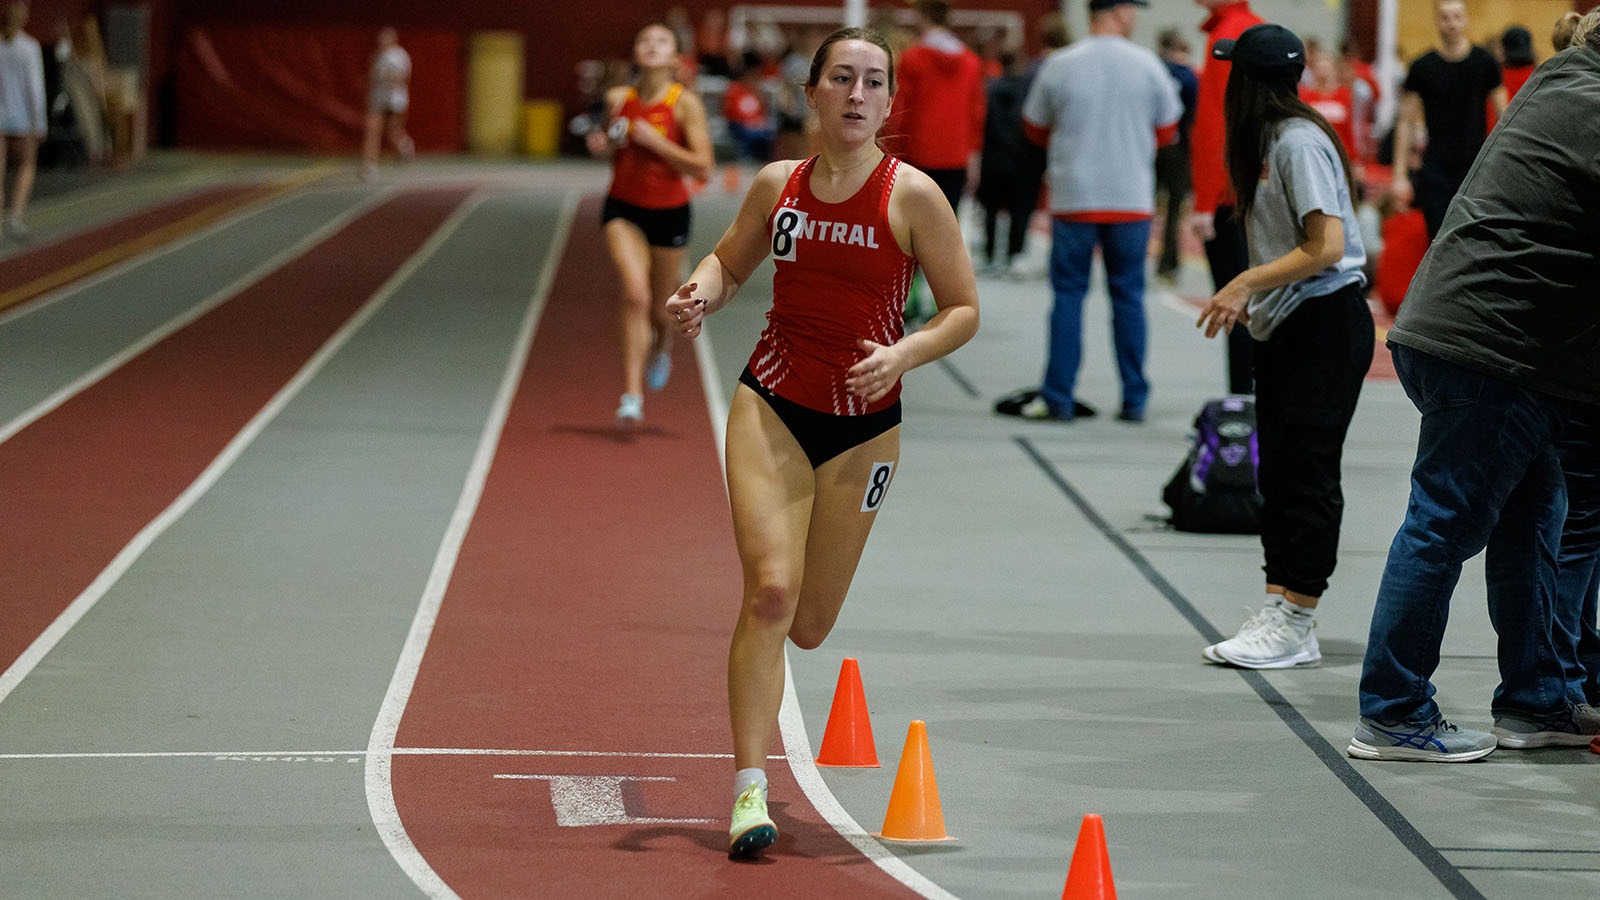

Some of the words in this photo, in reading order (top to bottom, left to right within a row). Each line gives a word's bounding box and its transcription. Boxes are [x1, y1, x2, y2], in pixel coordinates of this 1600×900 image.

[773, 211, 799, 257] 8
[798, 219, 880, 249] NTRAL
[866, 465, 890, 509] 8
